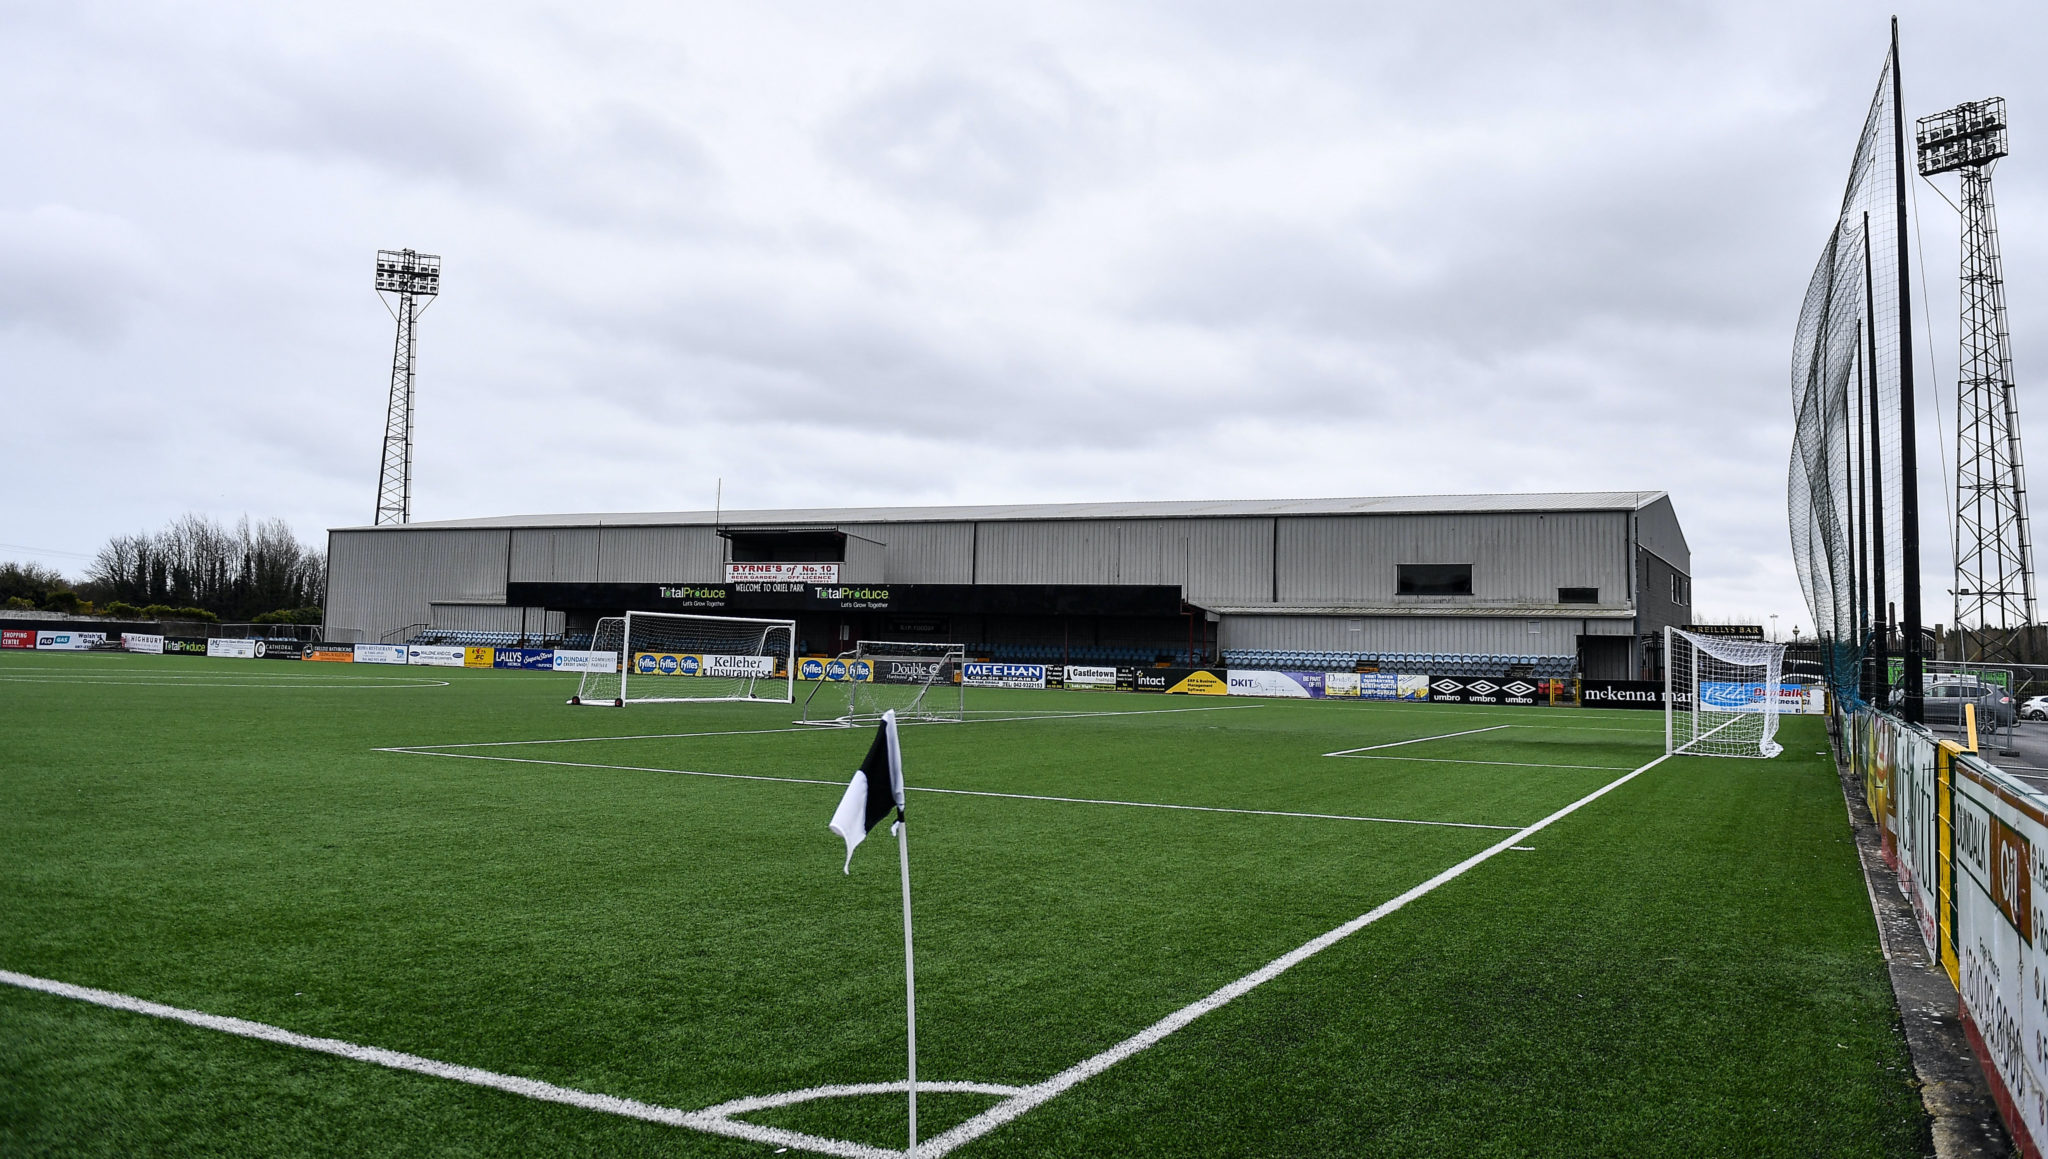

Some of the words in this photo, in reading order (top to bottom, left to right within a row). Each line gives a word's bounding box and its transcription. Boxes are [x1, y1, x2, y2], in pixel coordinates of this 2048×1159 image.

[786, 565, 798, 576] of
[659, 587, 726, 598] TotalProduce
[735, 583, 761, 592] WELCOME
[763, 583, 771, 592] TO
[772, 583, 788, 592] ORIEL
[789, 583, 805, 592] PARK
[815, 587, 889, 599] TotalProduce
[164, 640, 206, 652] TotalProduce
[496, 651, 522, 662] LALLYS
[714, 656, 762, 668] Kelleher
[639, 658, 656, 670] fyffes
[659, 658, 677, 670] fyffes
[681, 659, 699, 671] fyffes
[803, 663, 822, 675] fyffes
[891, 662, 927, 674] Double
[709, 667, 769, 678] Insurances
[967, 665, 1040, 676] MEEHAN
[1073, 668, 1115, 678] Castletown
[1138, 676, 1165, 685] intact
[1230, 679, 1254, 688] DKIT
[1584, 686, 1656, 702] mckenna
[1957, 802, 1987, 875] DUNDALK
[2000, 838, 2019, 912] Oil
[1987, 949, 2001, 983] Phone
[1966, 945, 1983, 1020] 1800
[1996, 996, 2023, 1097] 8000
